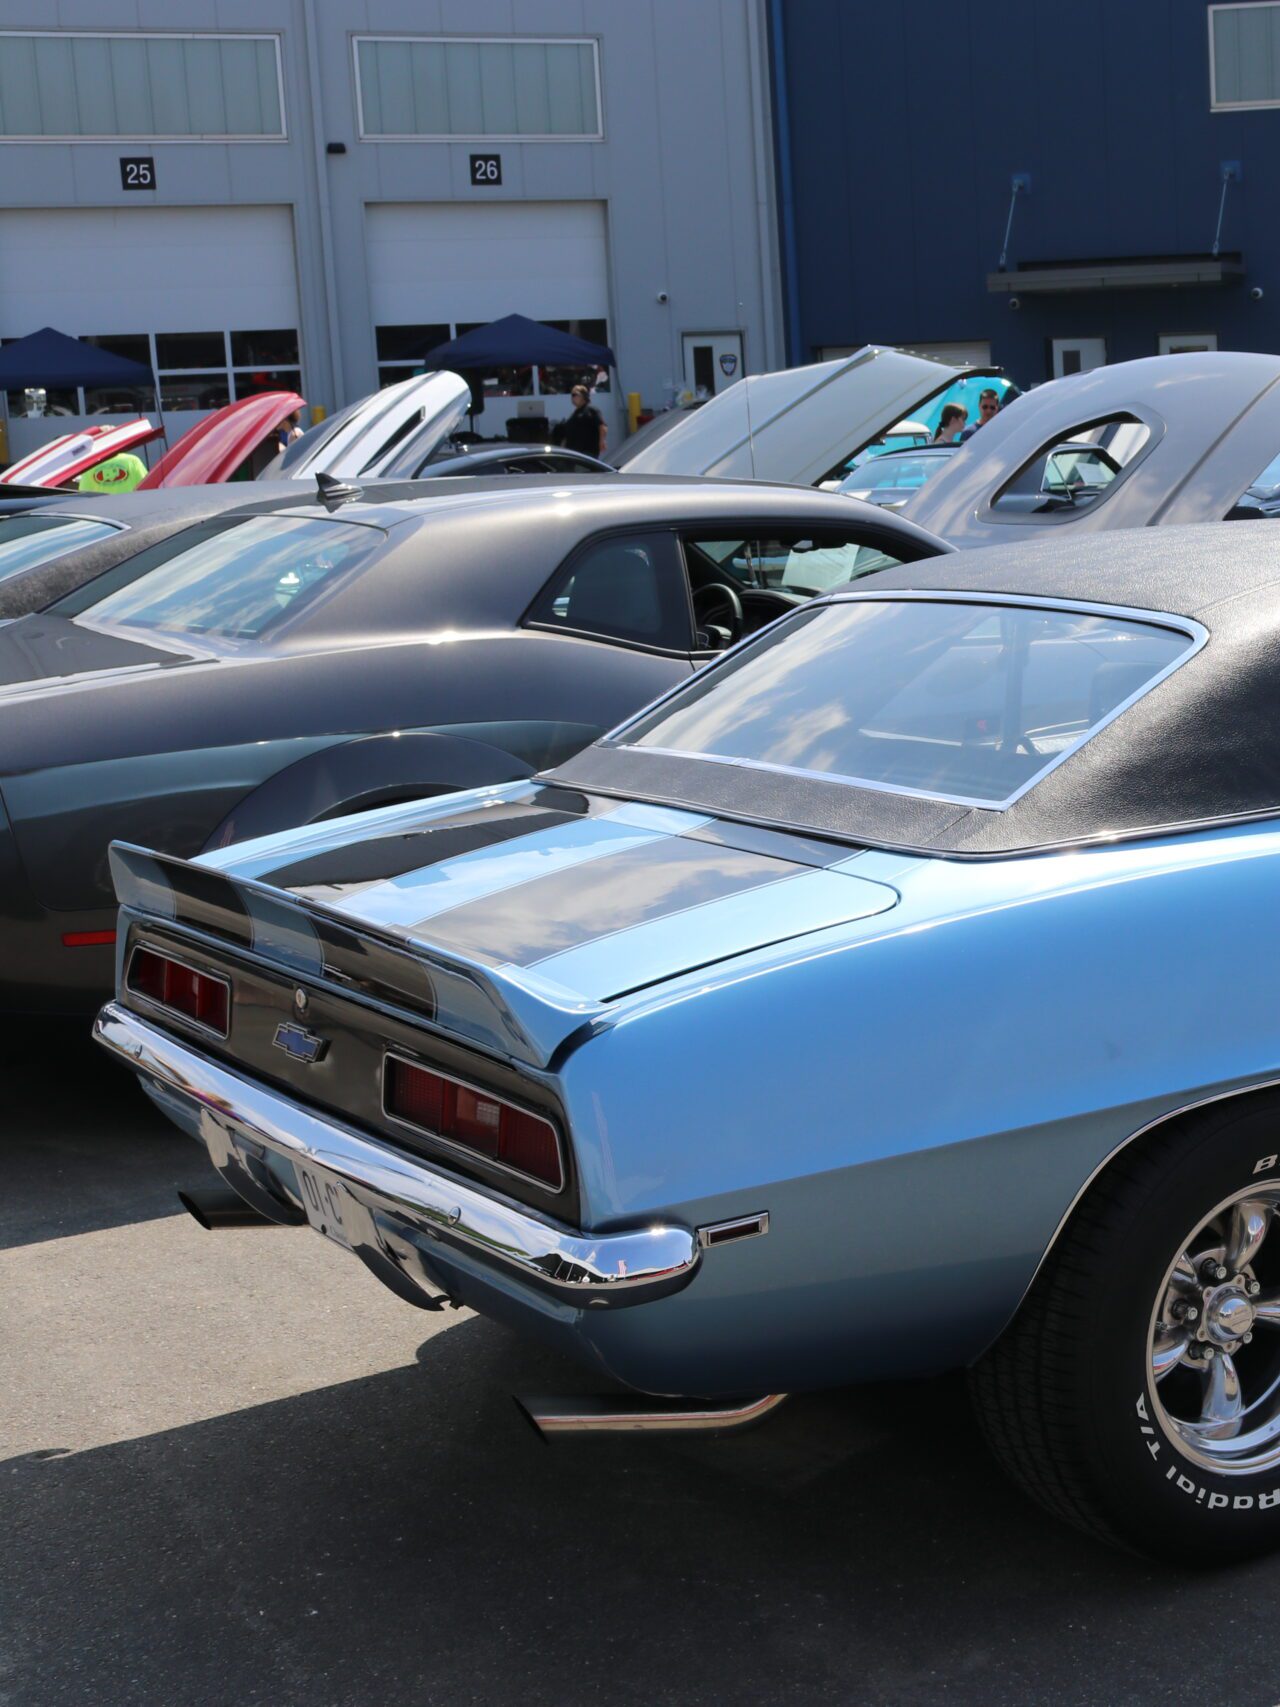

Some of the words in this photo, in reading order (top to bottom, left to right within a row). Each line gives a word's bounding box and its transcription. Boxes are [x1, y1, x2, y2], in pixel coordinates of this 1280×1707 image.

[126, 164, 151, 184] 25
[475, 160, 498, 180] 26
[1135, 1391, 1161, 1462] T/A
